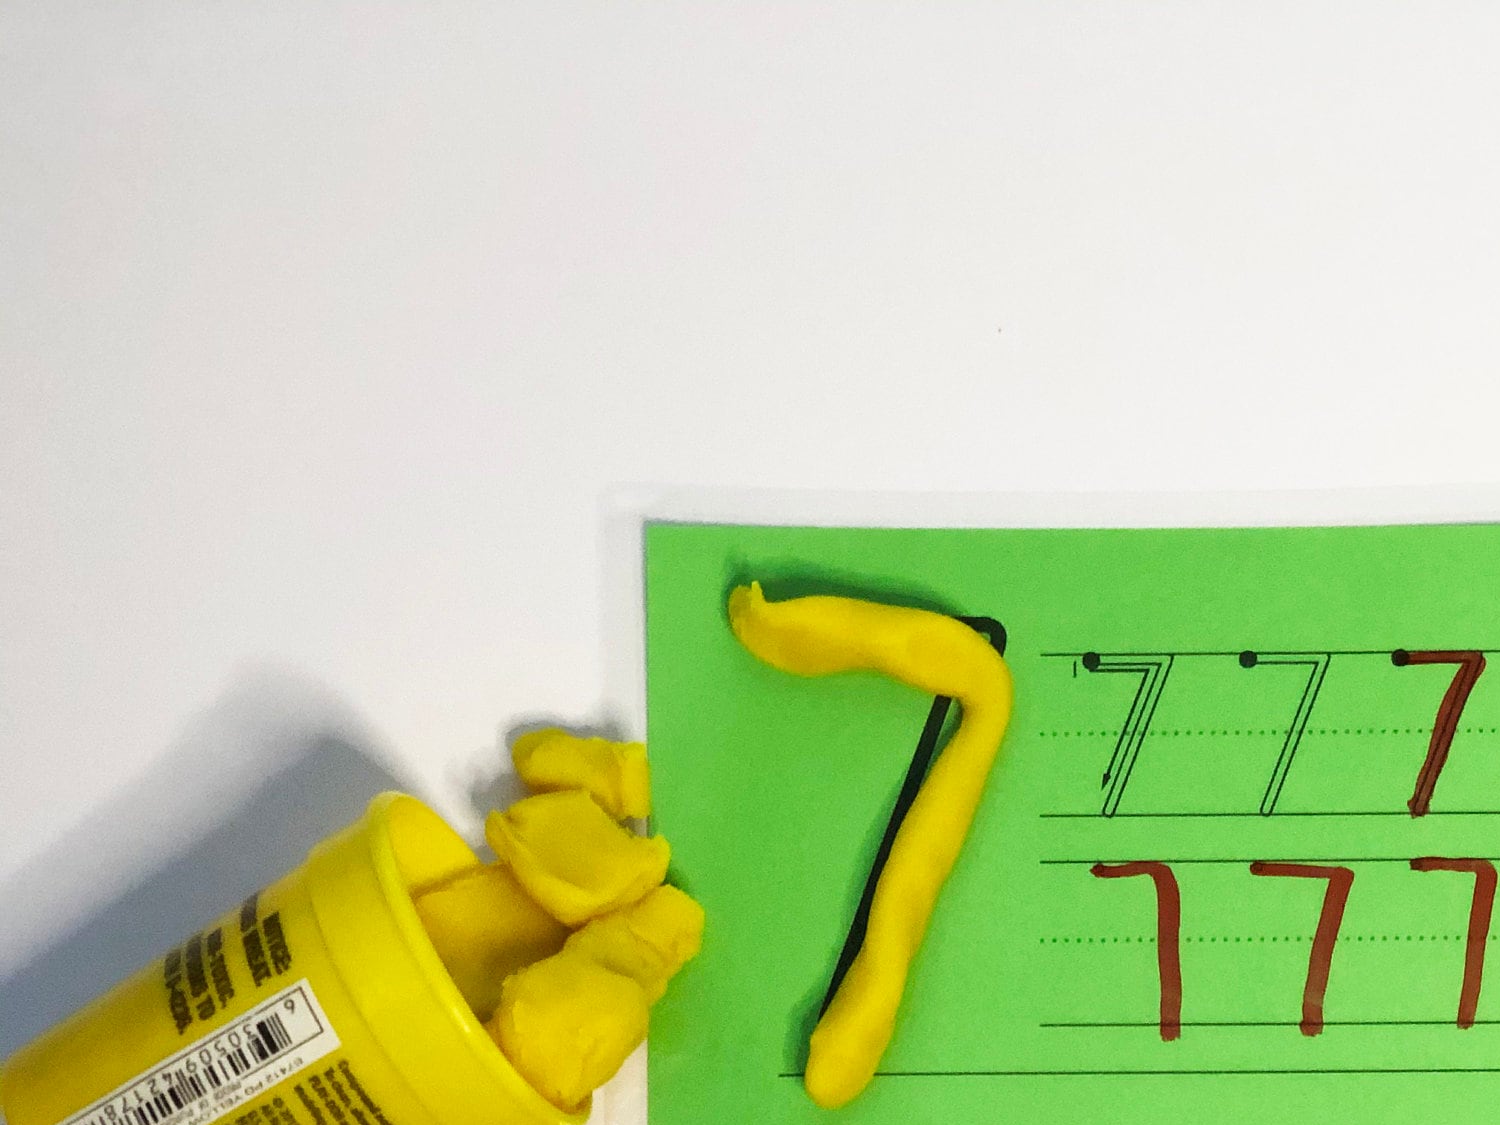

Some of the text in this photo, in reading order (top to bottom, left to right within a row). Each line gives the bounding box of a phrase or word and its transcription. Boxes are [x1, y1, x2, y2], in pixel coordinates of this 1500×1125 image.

[1082, 651, 1173, 818] 7
[1239, 650, 1330, 816] 7
[1391, 648, 1486, 819] 7
[1090, 861, 1181, 1041] 7
[1250, 861, 1354, 1036] 7
[1409, 857, 1498, 1029] 7
